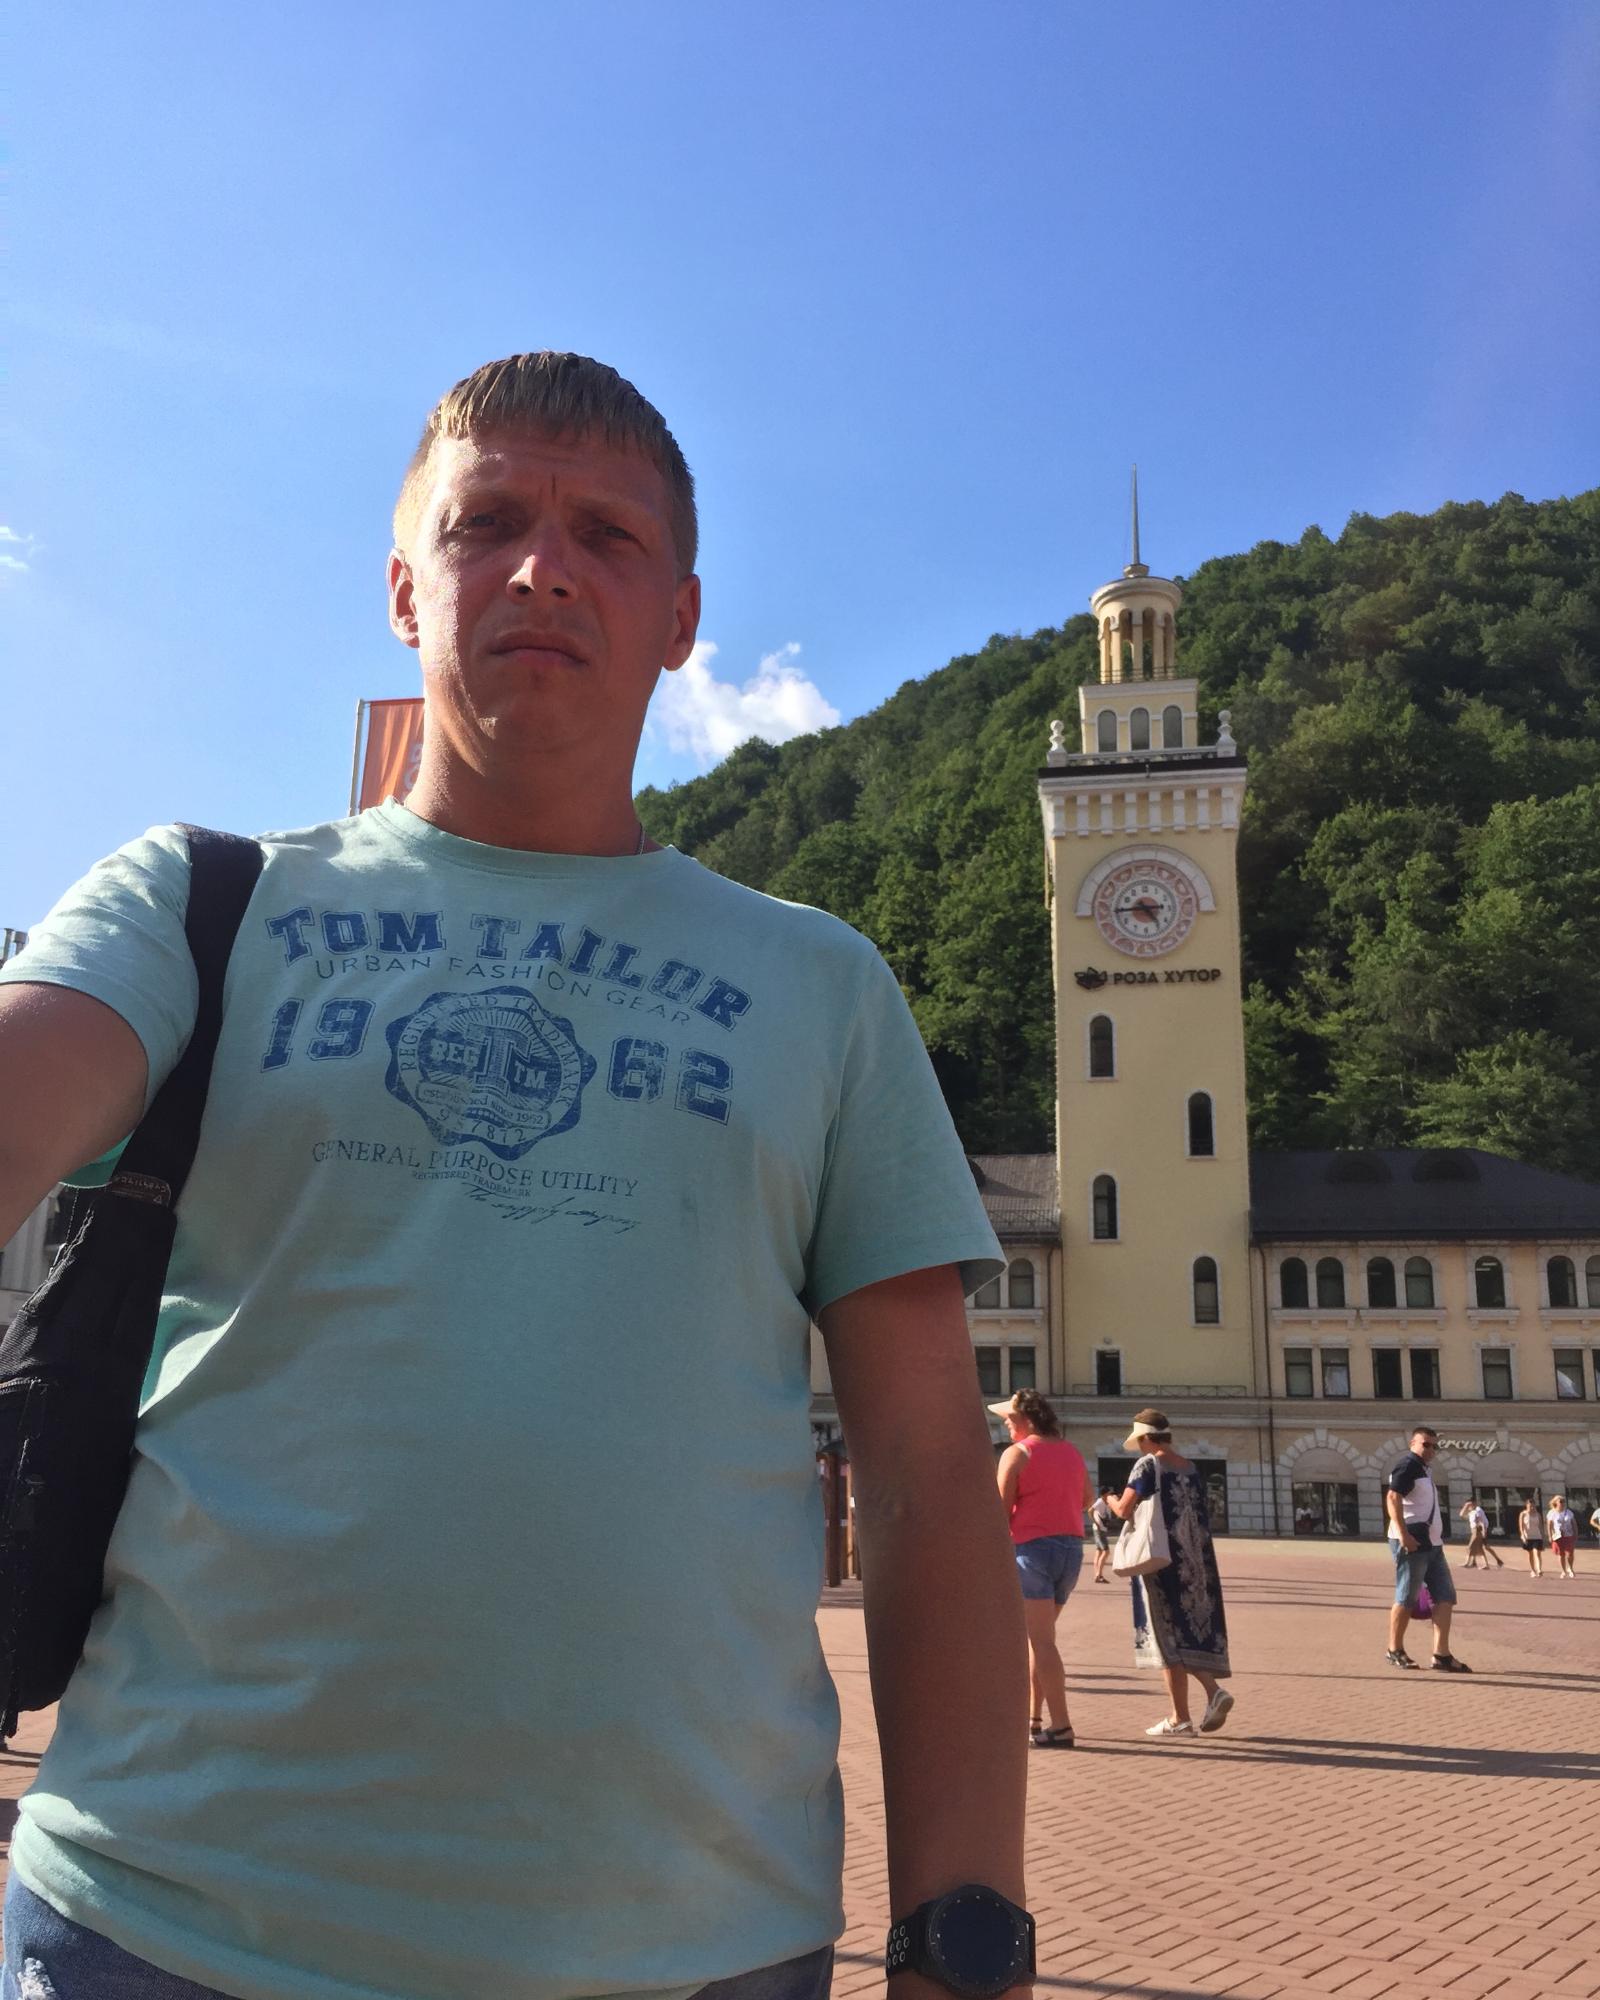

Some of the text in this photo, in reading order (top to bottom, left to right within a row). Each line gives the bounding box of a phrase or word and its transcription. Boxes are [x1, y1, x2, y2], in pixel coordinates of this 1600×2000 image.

[265, 906, 753, 1032] TOM TAILOR
[315, 955, 692, 1027] URBAN FASHION GEAR
[1114, 969, 1221, 984] РОЗА ХУТОР
[260, 997, 734, 1126] 19 62
[513, 997, 579, 1109] TRADEMARK
[429, 1151, 533, 1187] PURPOSE
[542, 1170, 639, 1197] UTILITY
[1436, 1432, 1498, 1455] ercury
